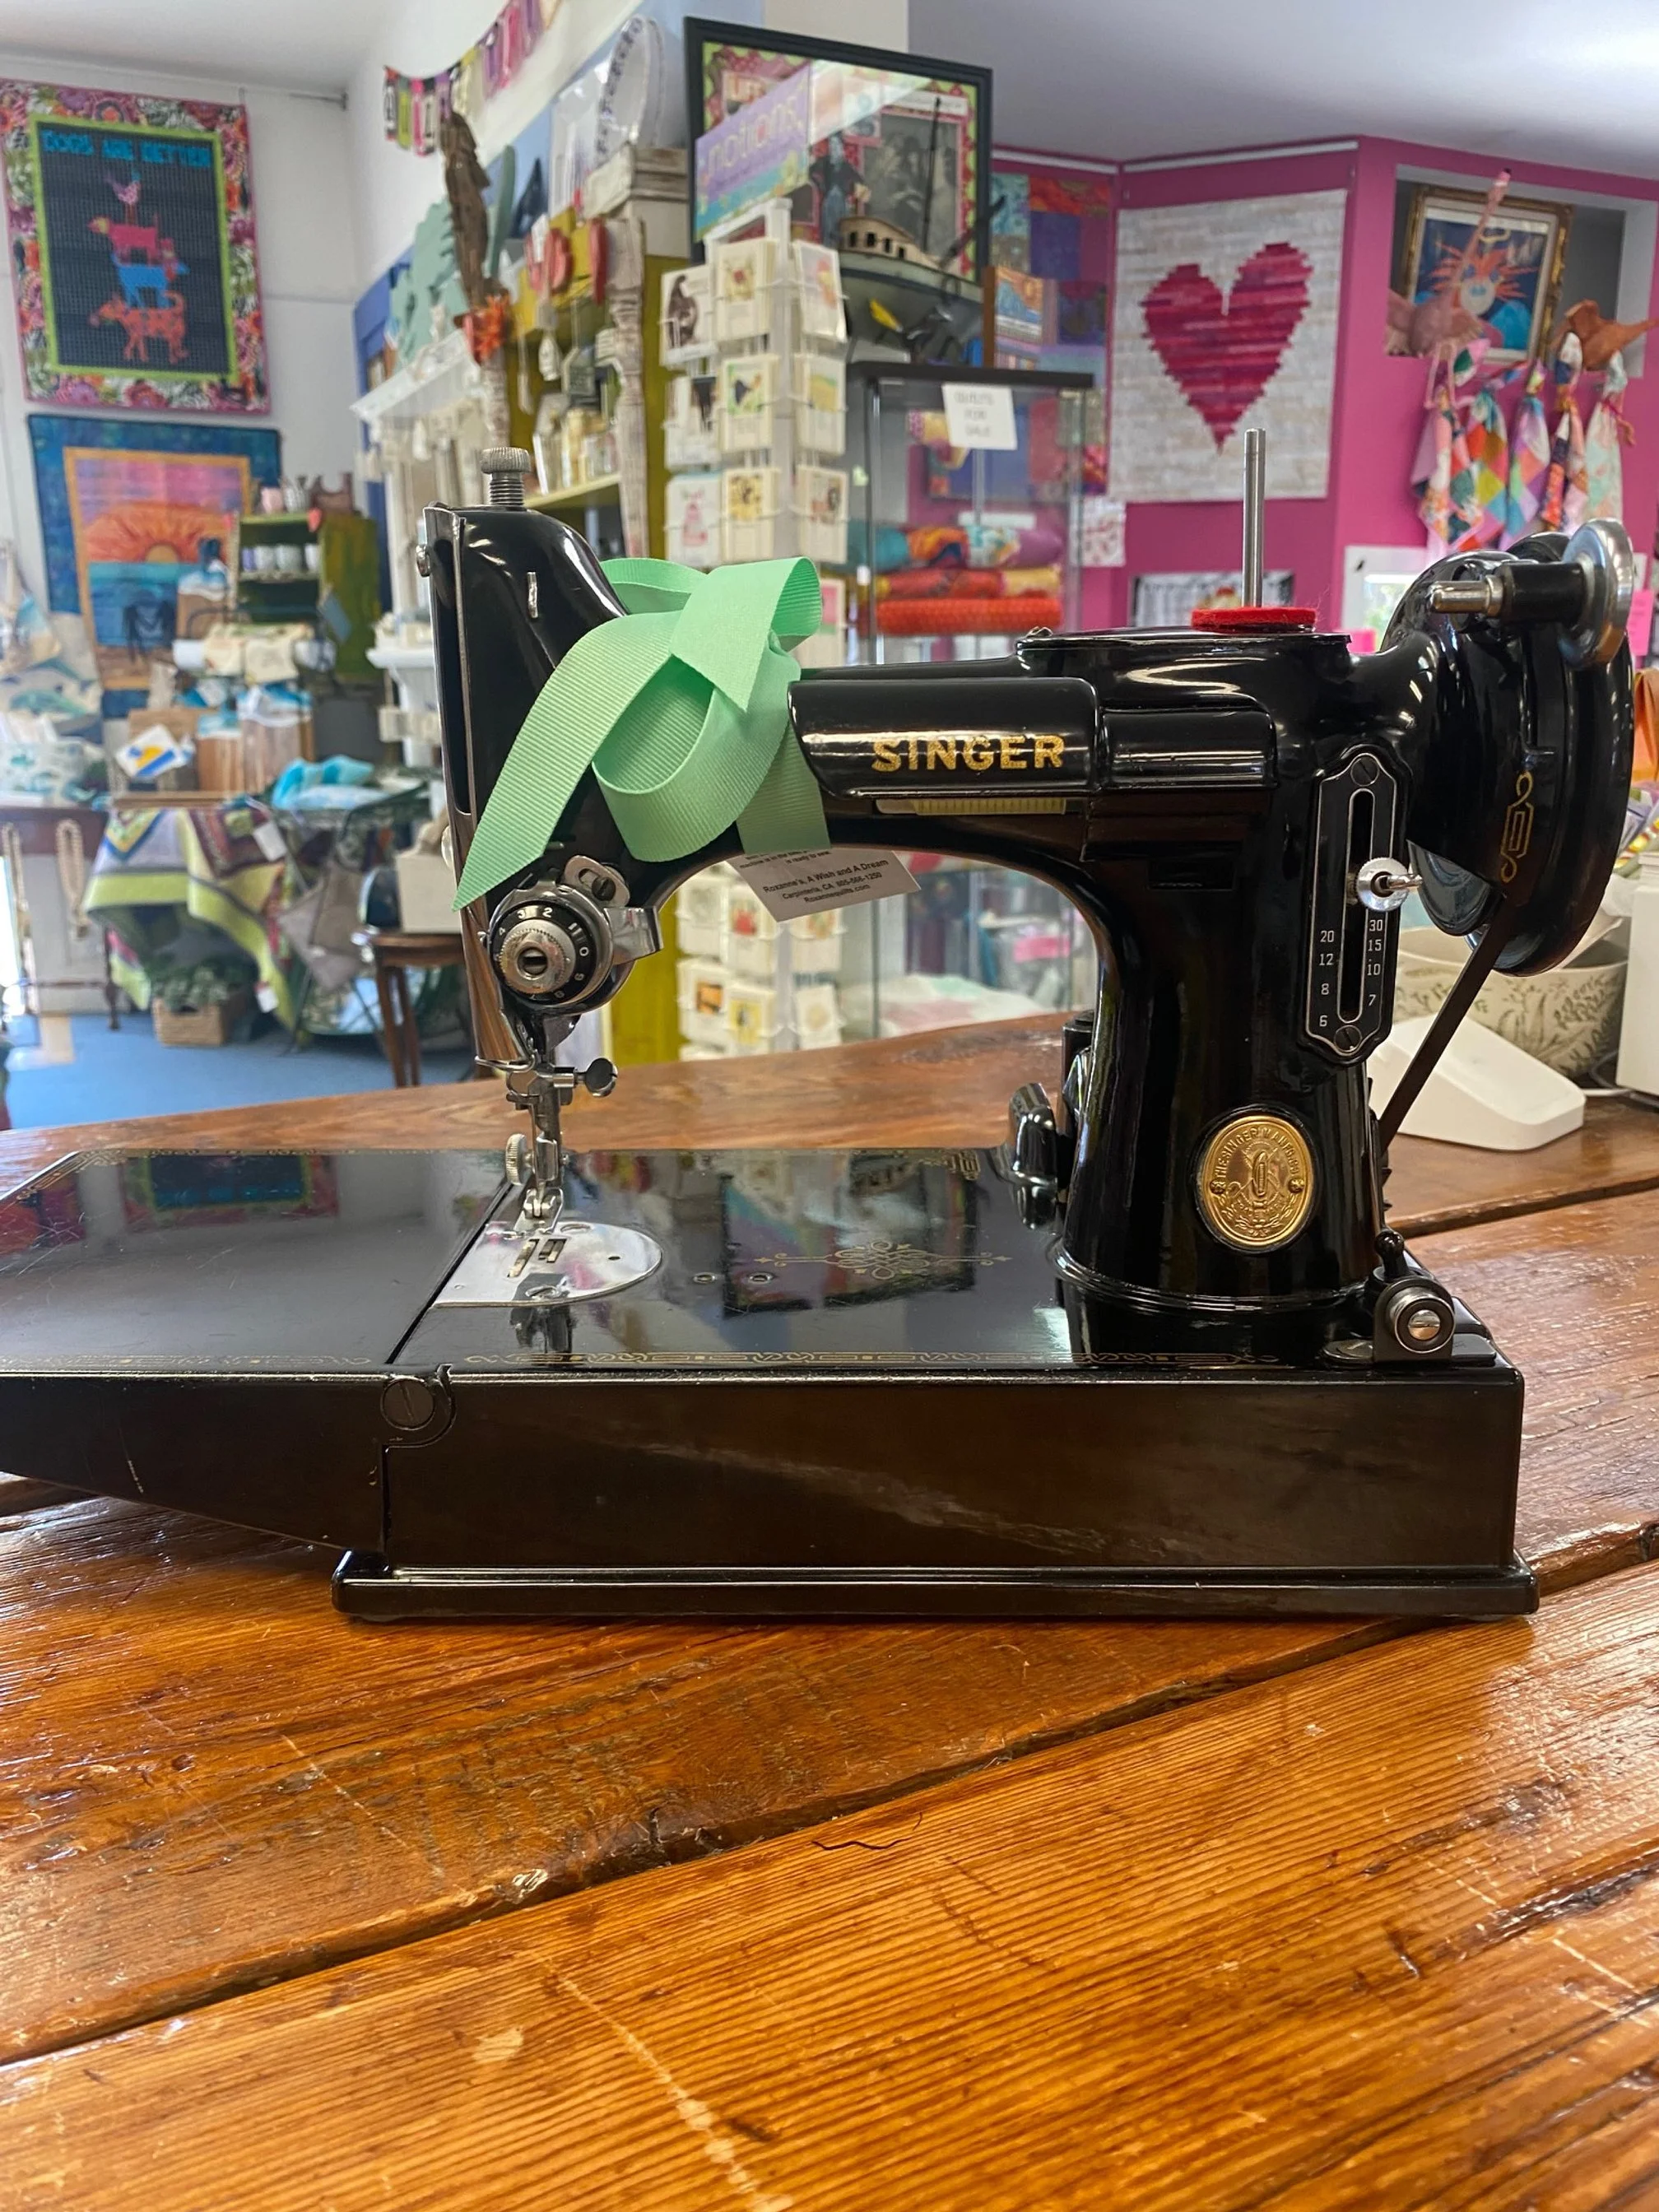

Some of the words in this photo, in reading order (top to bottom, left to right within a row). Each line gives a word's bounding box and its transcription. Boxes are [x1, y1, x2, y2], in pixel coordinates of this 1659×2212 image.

[871, 735, 1064, 772] SINGER
[807, 875, 816, 883] A
[814, 871, 836, 881] Wish
[836, 867, 853, 876] and
[860, 859, 889, 871] Dream
[517, 909, 526, 919] 3
[542, 907, 553, 918] 2
[499, 927, 506, 936] 4
[1369, 919, 1382, 932] 30
[1320, 930, 1335, 942] 20
[579, 946, 589, 956] 0
[1368, 939, 1382, 951] 15
[1319, 953, 1333, 965] 12
[1367, 963, 1381, 975] 10
[1321, 983, 1329, 995] 8
[1369, 994, 1376, 1006] 7
[1319, 1015, 1327, 1027] 6
[1222, 1127, 1258, 1159] SINGER
